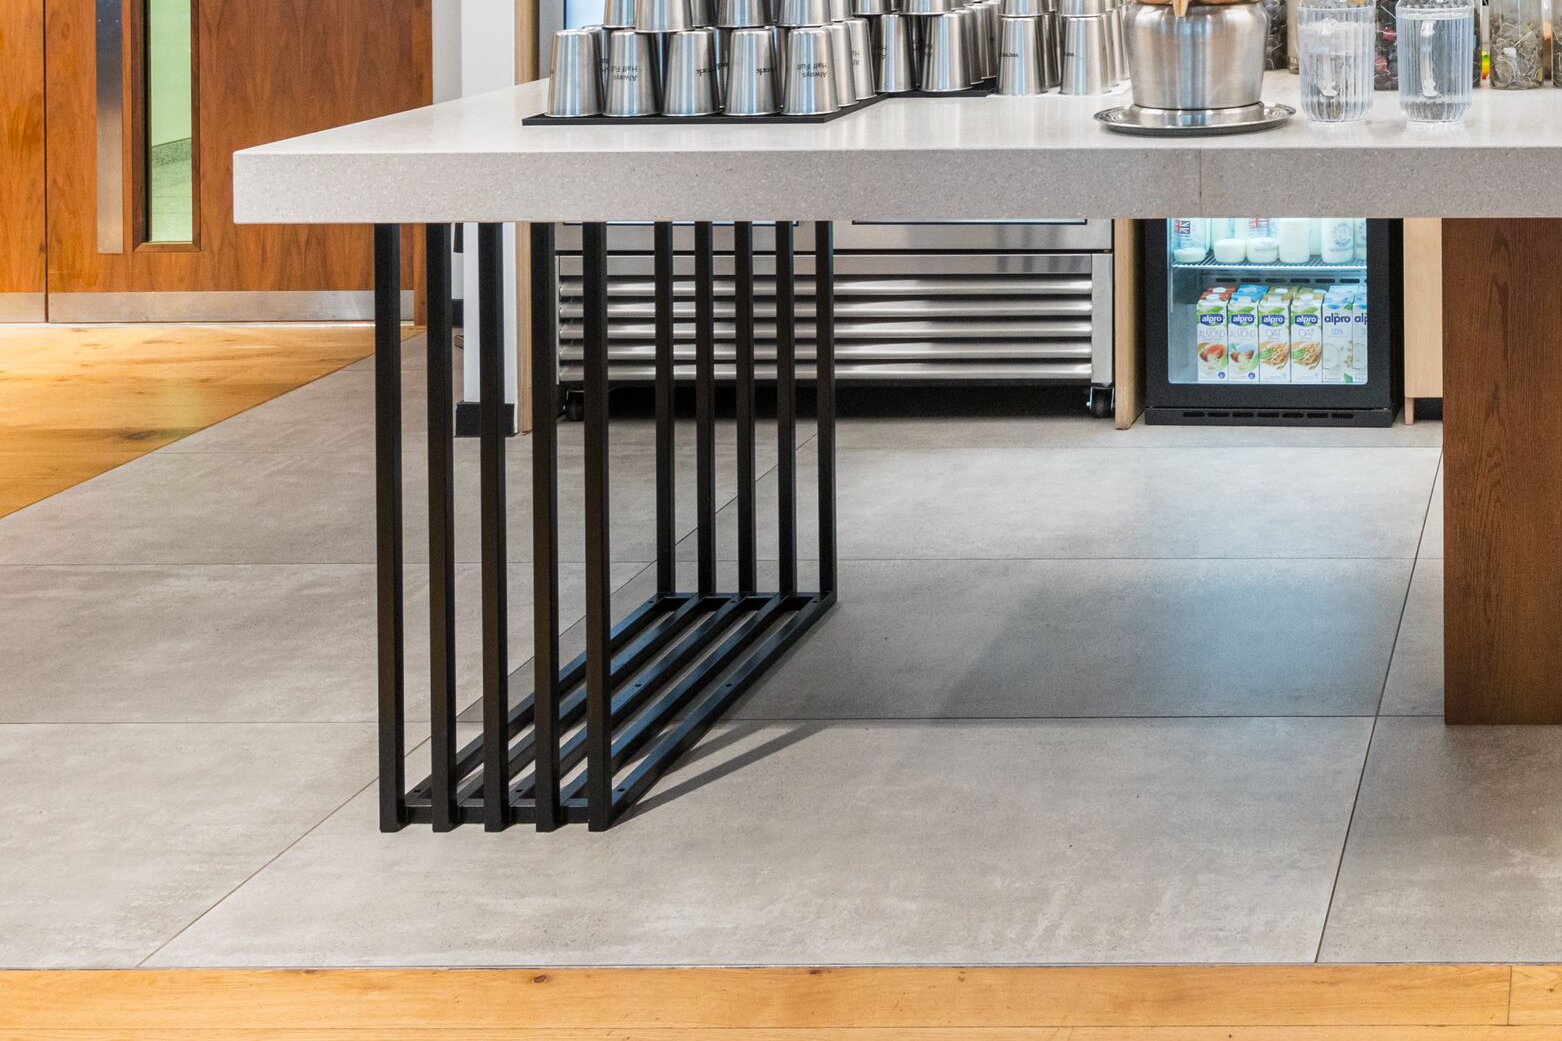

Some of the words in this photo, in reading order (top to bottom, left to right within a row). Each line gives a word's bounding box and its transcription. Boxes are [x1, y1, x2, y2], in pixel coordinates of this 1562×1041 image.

[1201, 314, 1222, 324] alpro
[1232, 314, 1253, 324] alpro
[1263, 315, 1284, 324] alpro
[1296, 315, 1317, 324] alpro
[1324, 313, 1351, 325] alpro
[1354, 313, 1368, 325] alp
